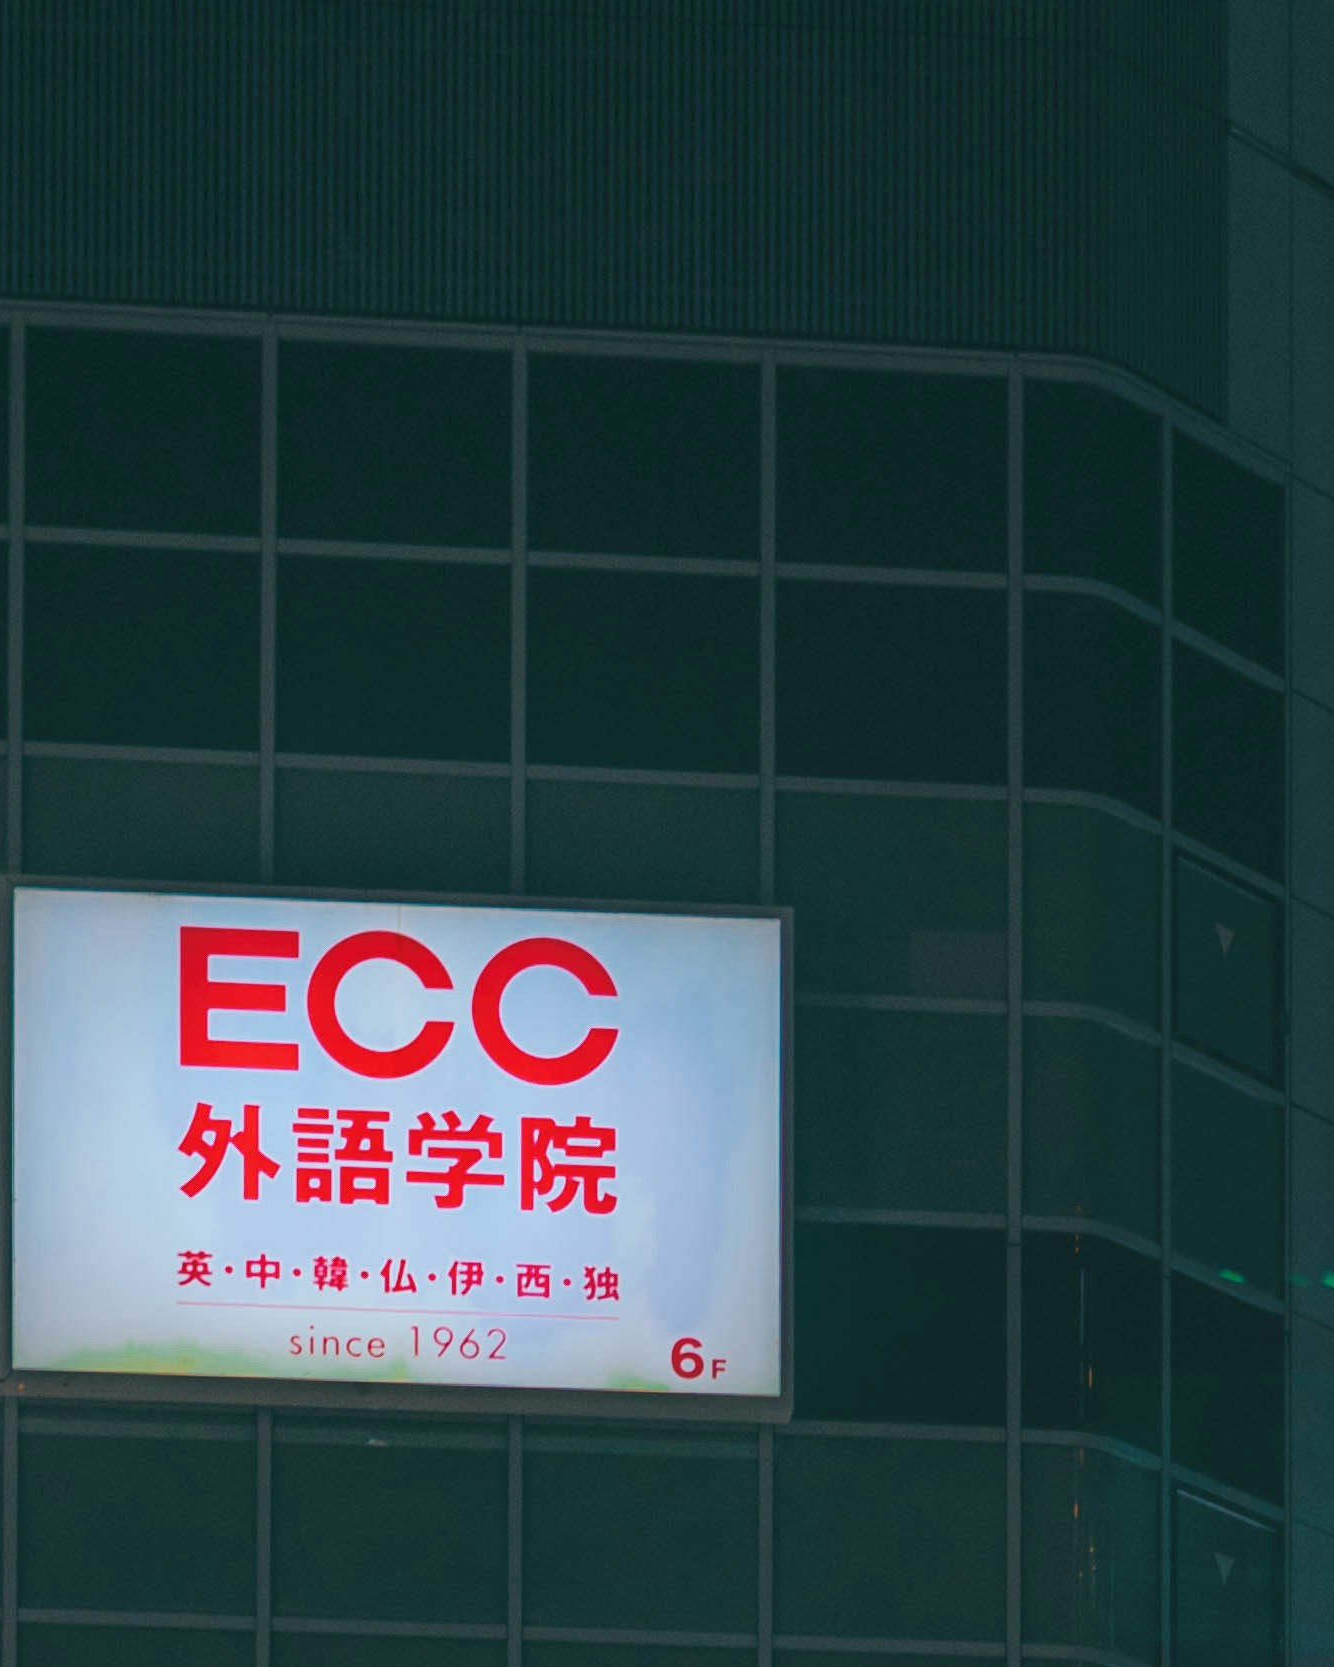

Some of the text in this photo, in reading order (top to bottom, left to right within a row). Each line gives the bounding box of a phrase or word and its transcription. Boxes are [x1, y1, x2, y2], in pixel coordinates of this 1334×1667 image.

[179, 926, 619, 1086] ECC
[178, 1102, 618, 1215] 外語学院
[177, 1250, 620, 1302] 英・中・韓・仏・伊・西・独
[288, 1325, 508, 1361] since 1962
[670, 1337, 728, 1381] 6F
